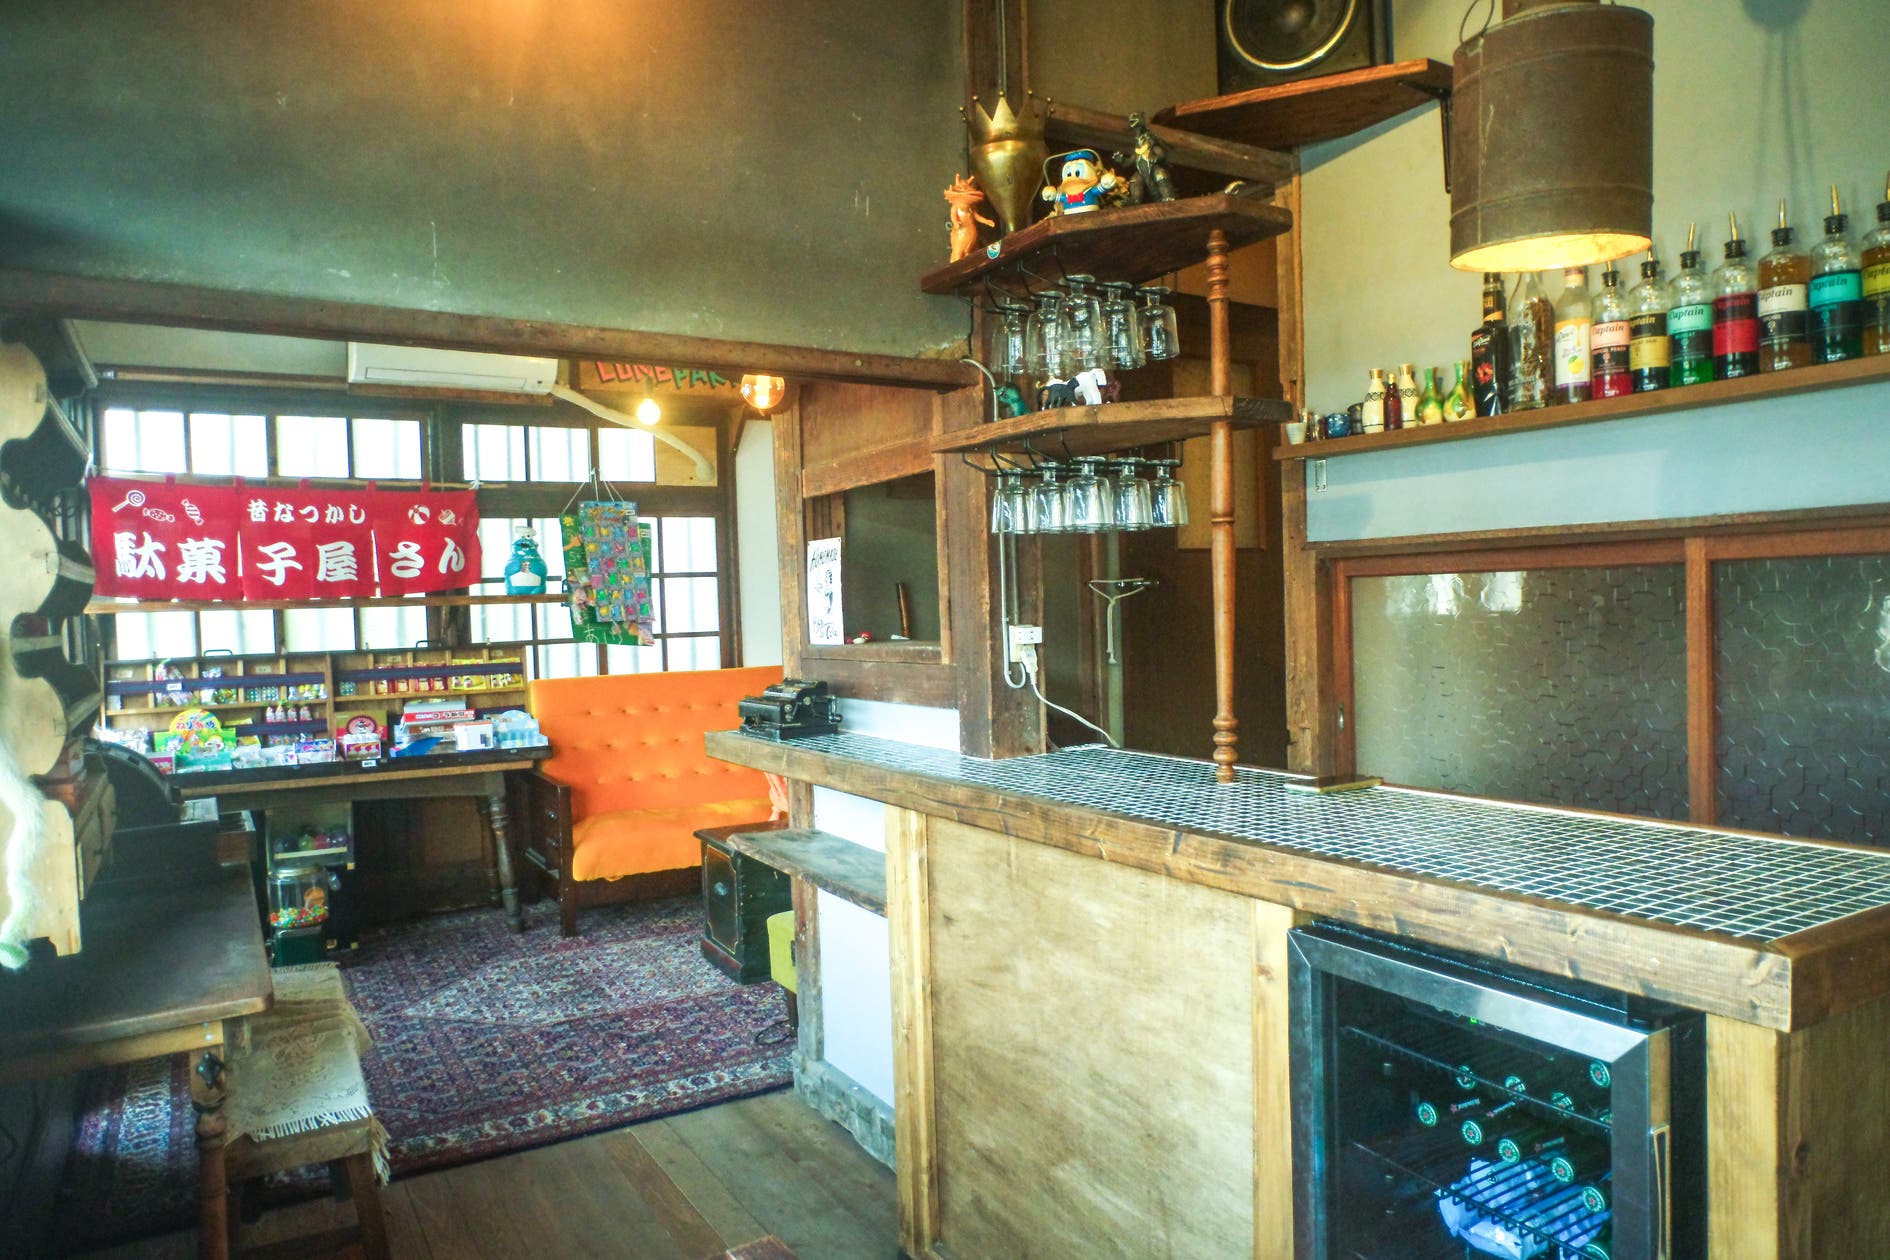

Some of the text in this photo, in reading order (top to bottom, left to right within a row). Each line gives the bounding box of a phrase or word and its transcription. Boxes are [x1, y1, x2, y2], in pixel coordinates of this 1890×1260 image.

[1669, 306, 1704, 320] Captain
[1592, 324, 1625, 337] Captain
[248, 499, 366, 524] 昔なつかし
[114, 531, 466, 586] 駄菓子屋さん
